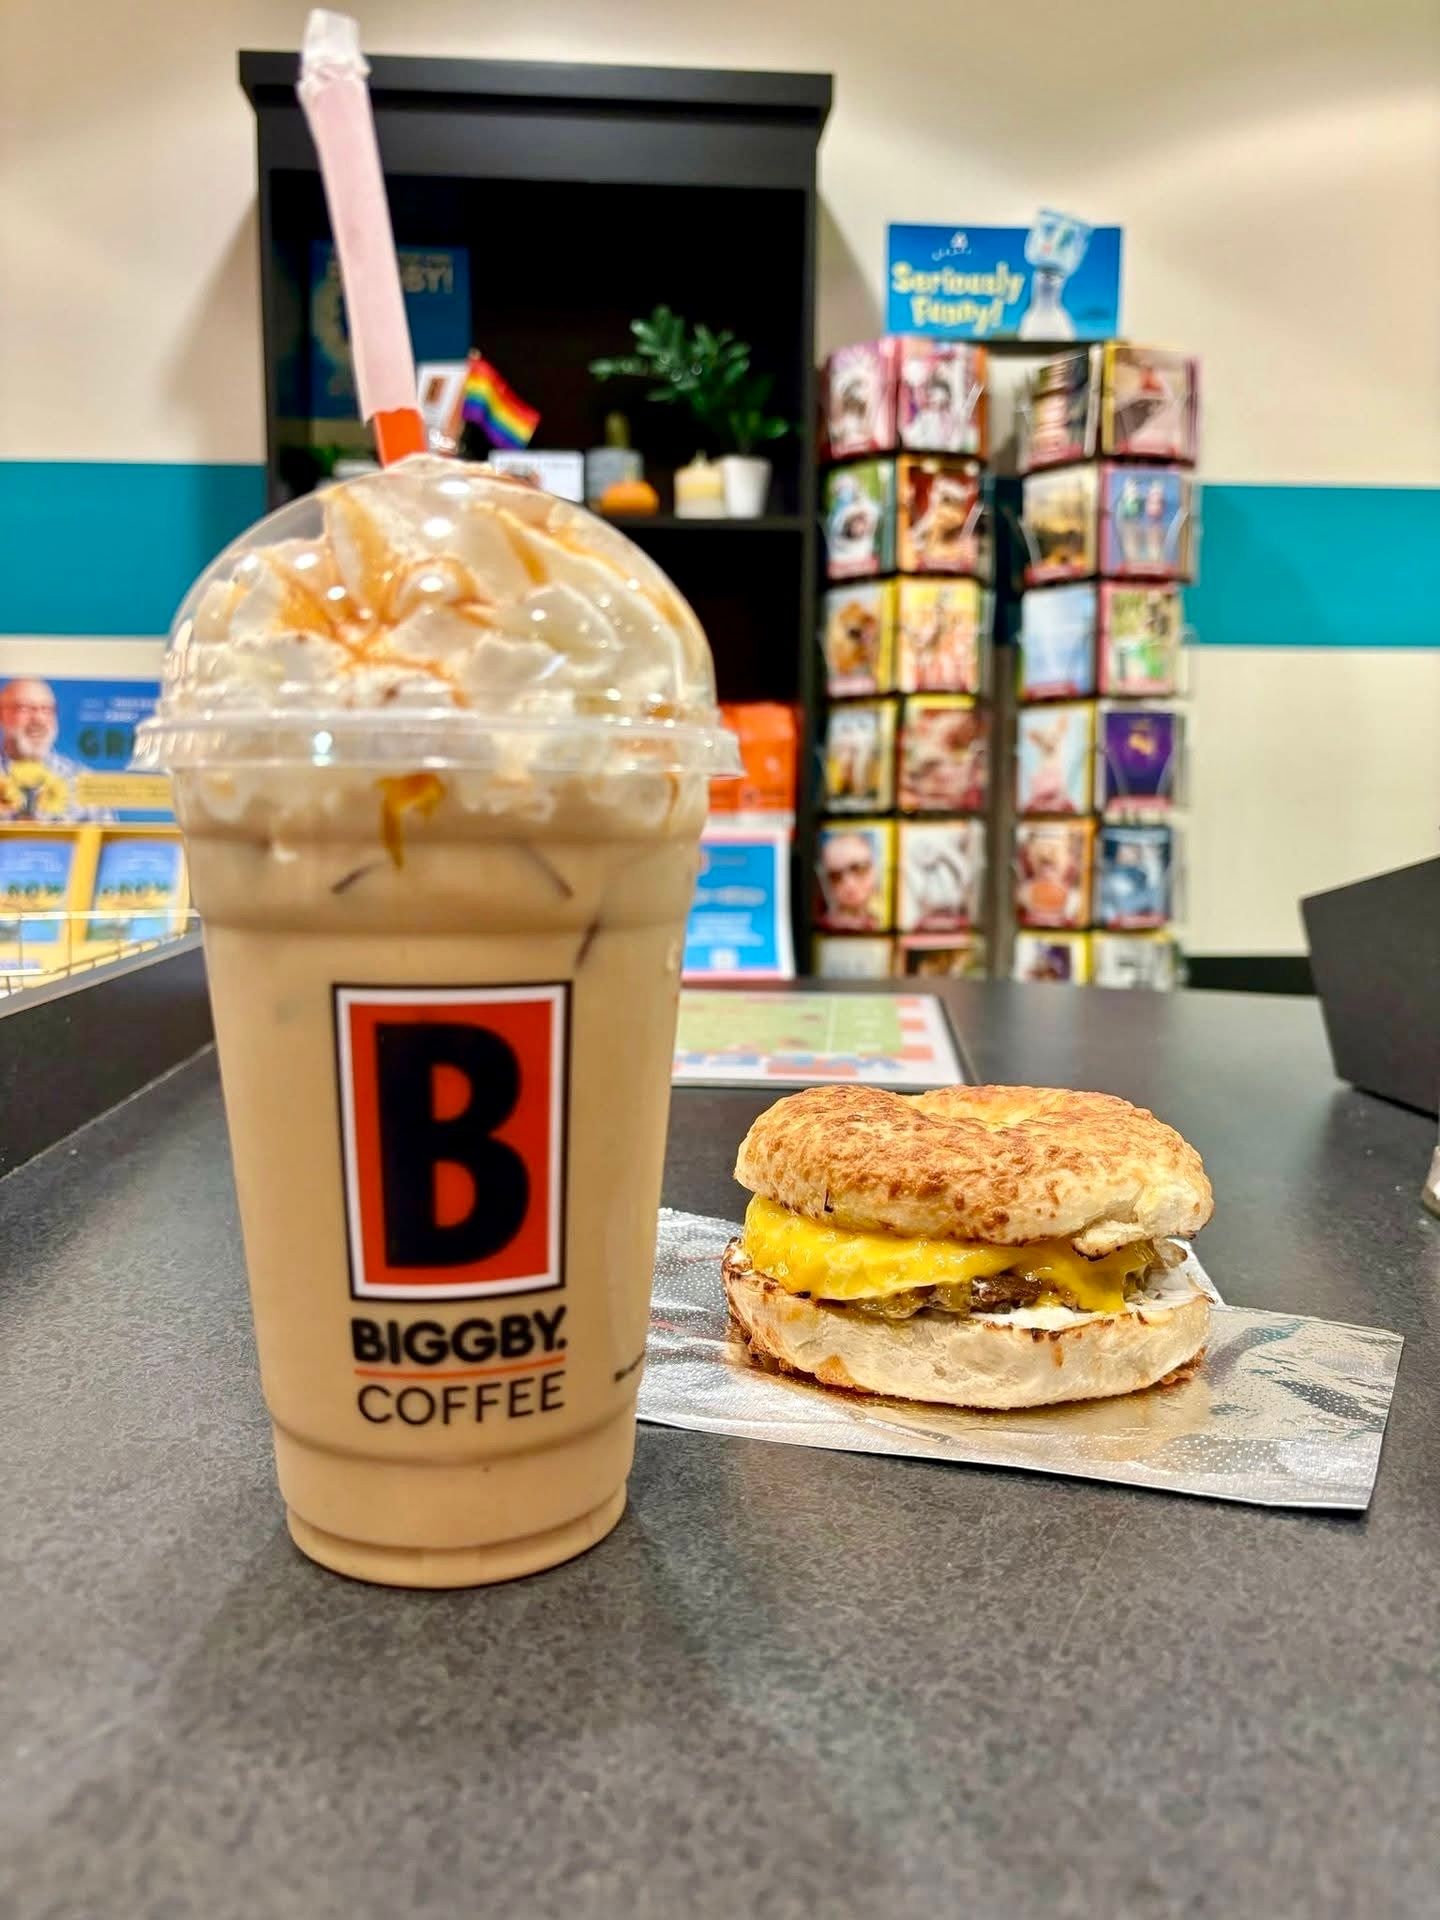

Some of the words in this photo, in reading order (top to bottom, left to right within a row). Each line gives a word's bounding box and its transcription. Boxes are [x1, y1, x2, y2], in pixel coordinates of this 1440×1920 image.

[892, 261, 1025, 304] Seriously
[375, 1022, 530, 1268] B
[357, 1369, 566, 1426] COFFEE
